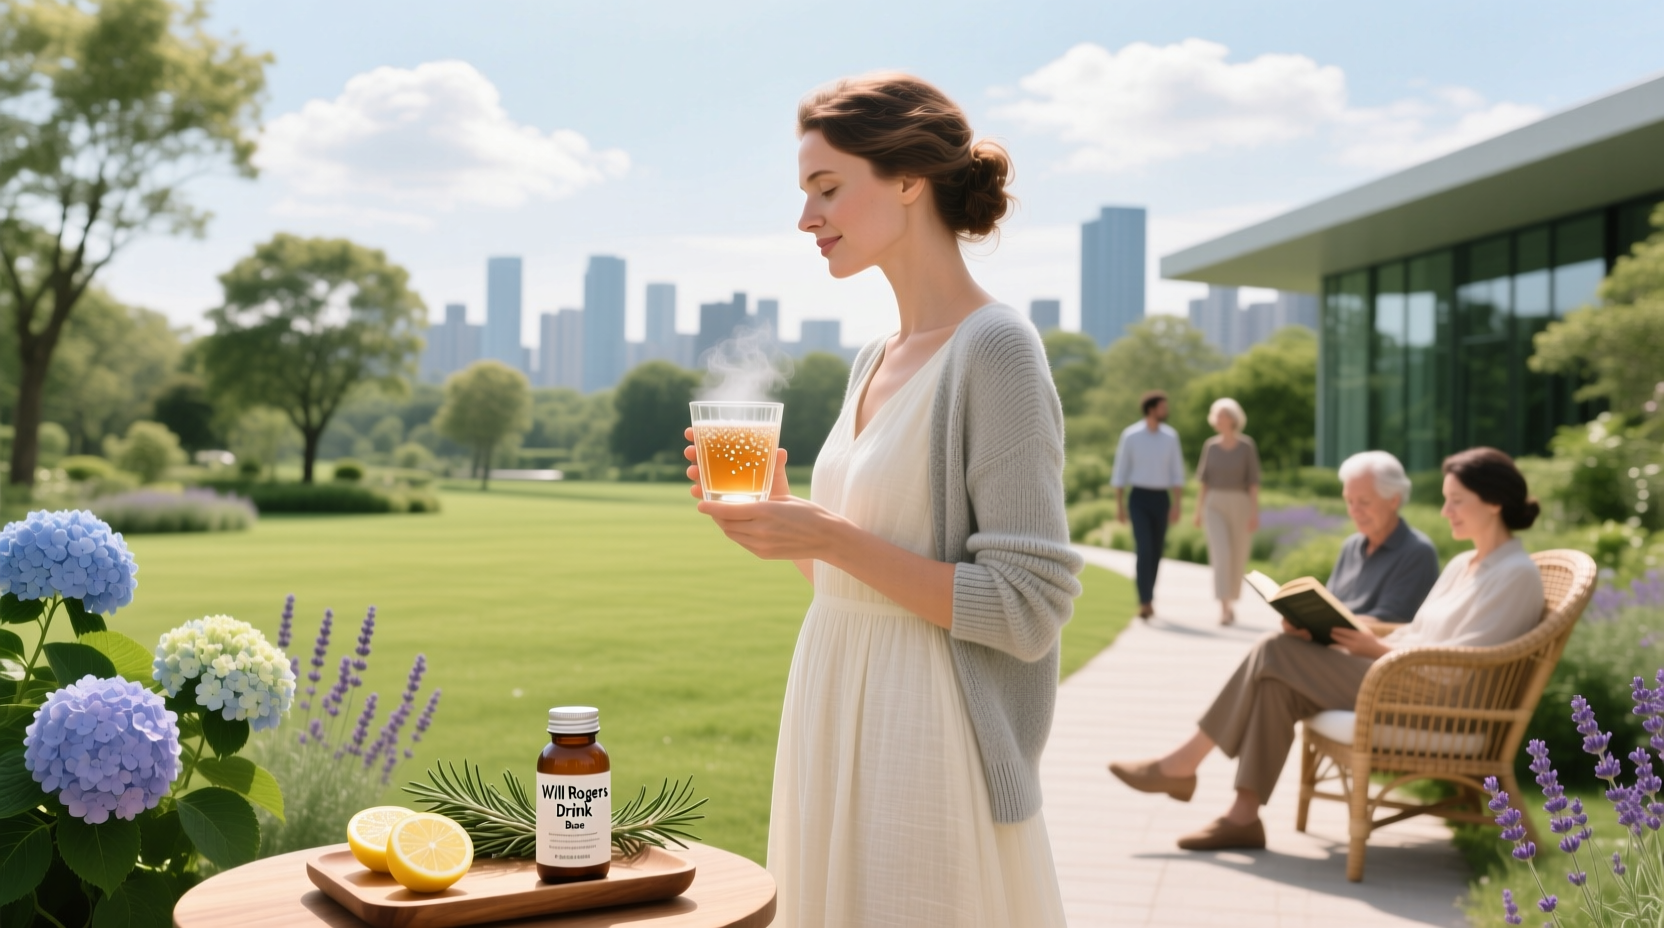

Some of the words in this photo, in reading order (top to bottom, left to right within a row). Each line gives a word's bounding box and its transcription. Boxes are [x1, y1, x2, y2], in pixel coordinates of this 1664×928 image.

[542, 784, 565, 800] Will
[568, 785, 609, 803] Rogers
[556, 801, 593, 818] Drink
